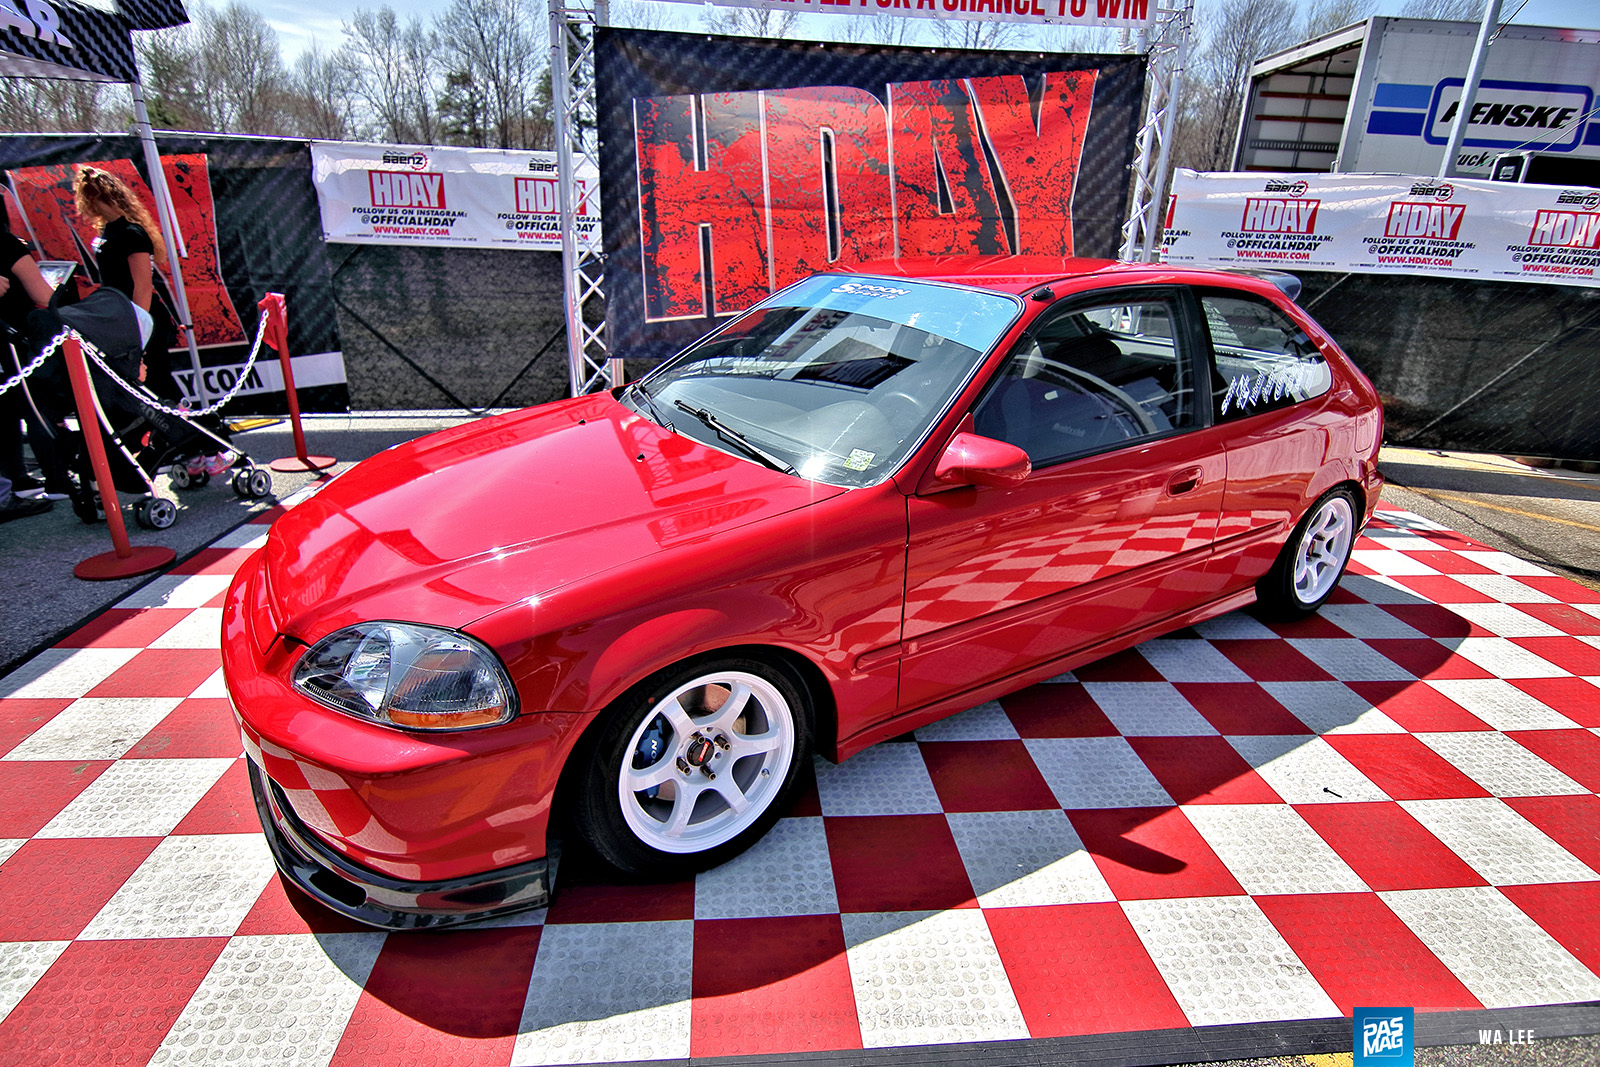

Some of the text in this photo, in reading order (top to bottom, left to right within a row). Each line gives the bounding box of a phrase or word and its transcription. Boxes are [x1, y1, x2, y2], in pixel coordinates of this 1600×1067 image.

[1097, 0, 1148, 20] WIN
[1456, 151, 1487, 167] uck
[529, 163, 558, 172] sae
[371, 172, 442, 207] HDAY
[633, 69, 1101, 322] HDAY
[517, 179, 584, 214] HD
[352, 207, 385, 215] FOLLOW
[416, 209, 468, 218] INSTAGRAM:
[1244, 200, 1317, 232] HDAY
[360, 214, 457, 227] @OFFICIALHDAY
[1387, 204, 1464, 239] HDAY
[373, 226, 450, 236] WWW.HDAY.COM
[517, 231, 589, 241] WWW.HDAM
[1221, 231, 1253, 240] FOLLOW
[1283, 234, 1334, 243] INSTAGRAM:
[1226, 239, 1321, 251] @OFFICIALHDAY
[1362, 237, 1396, 245] FOLLOW
[1428, 240, 1477, 250] INSTAGRAM:
[1236, 250, 1310, 260] WWW.HDAY.COM
[1368, 245, 1464, 258] @OFFICIALHDAY
[1378, 256, 1453, 267] WWW.HDAY.COM
[1522, 264, 1594, 276] WWW.HDAY.COM
[831, 283, 911, 295] SPOON
[177, 366, 263, 397] YCOM
